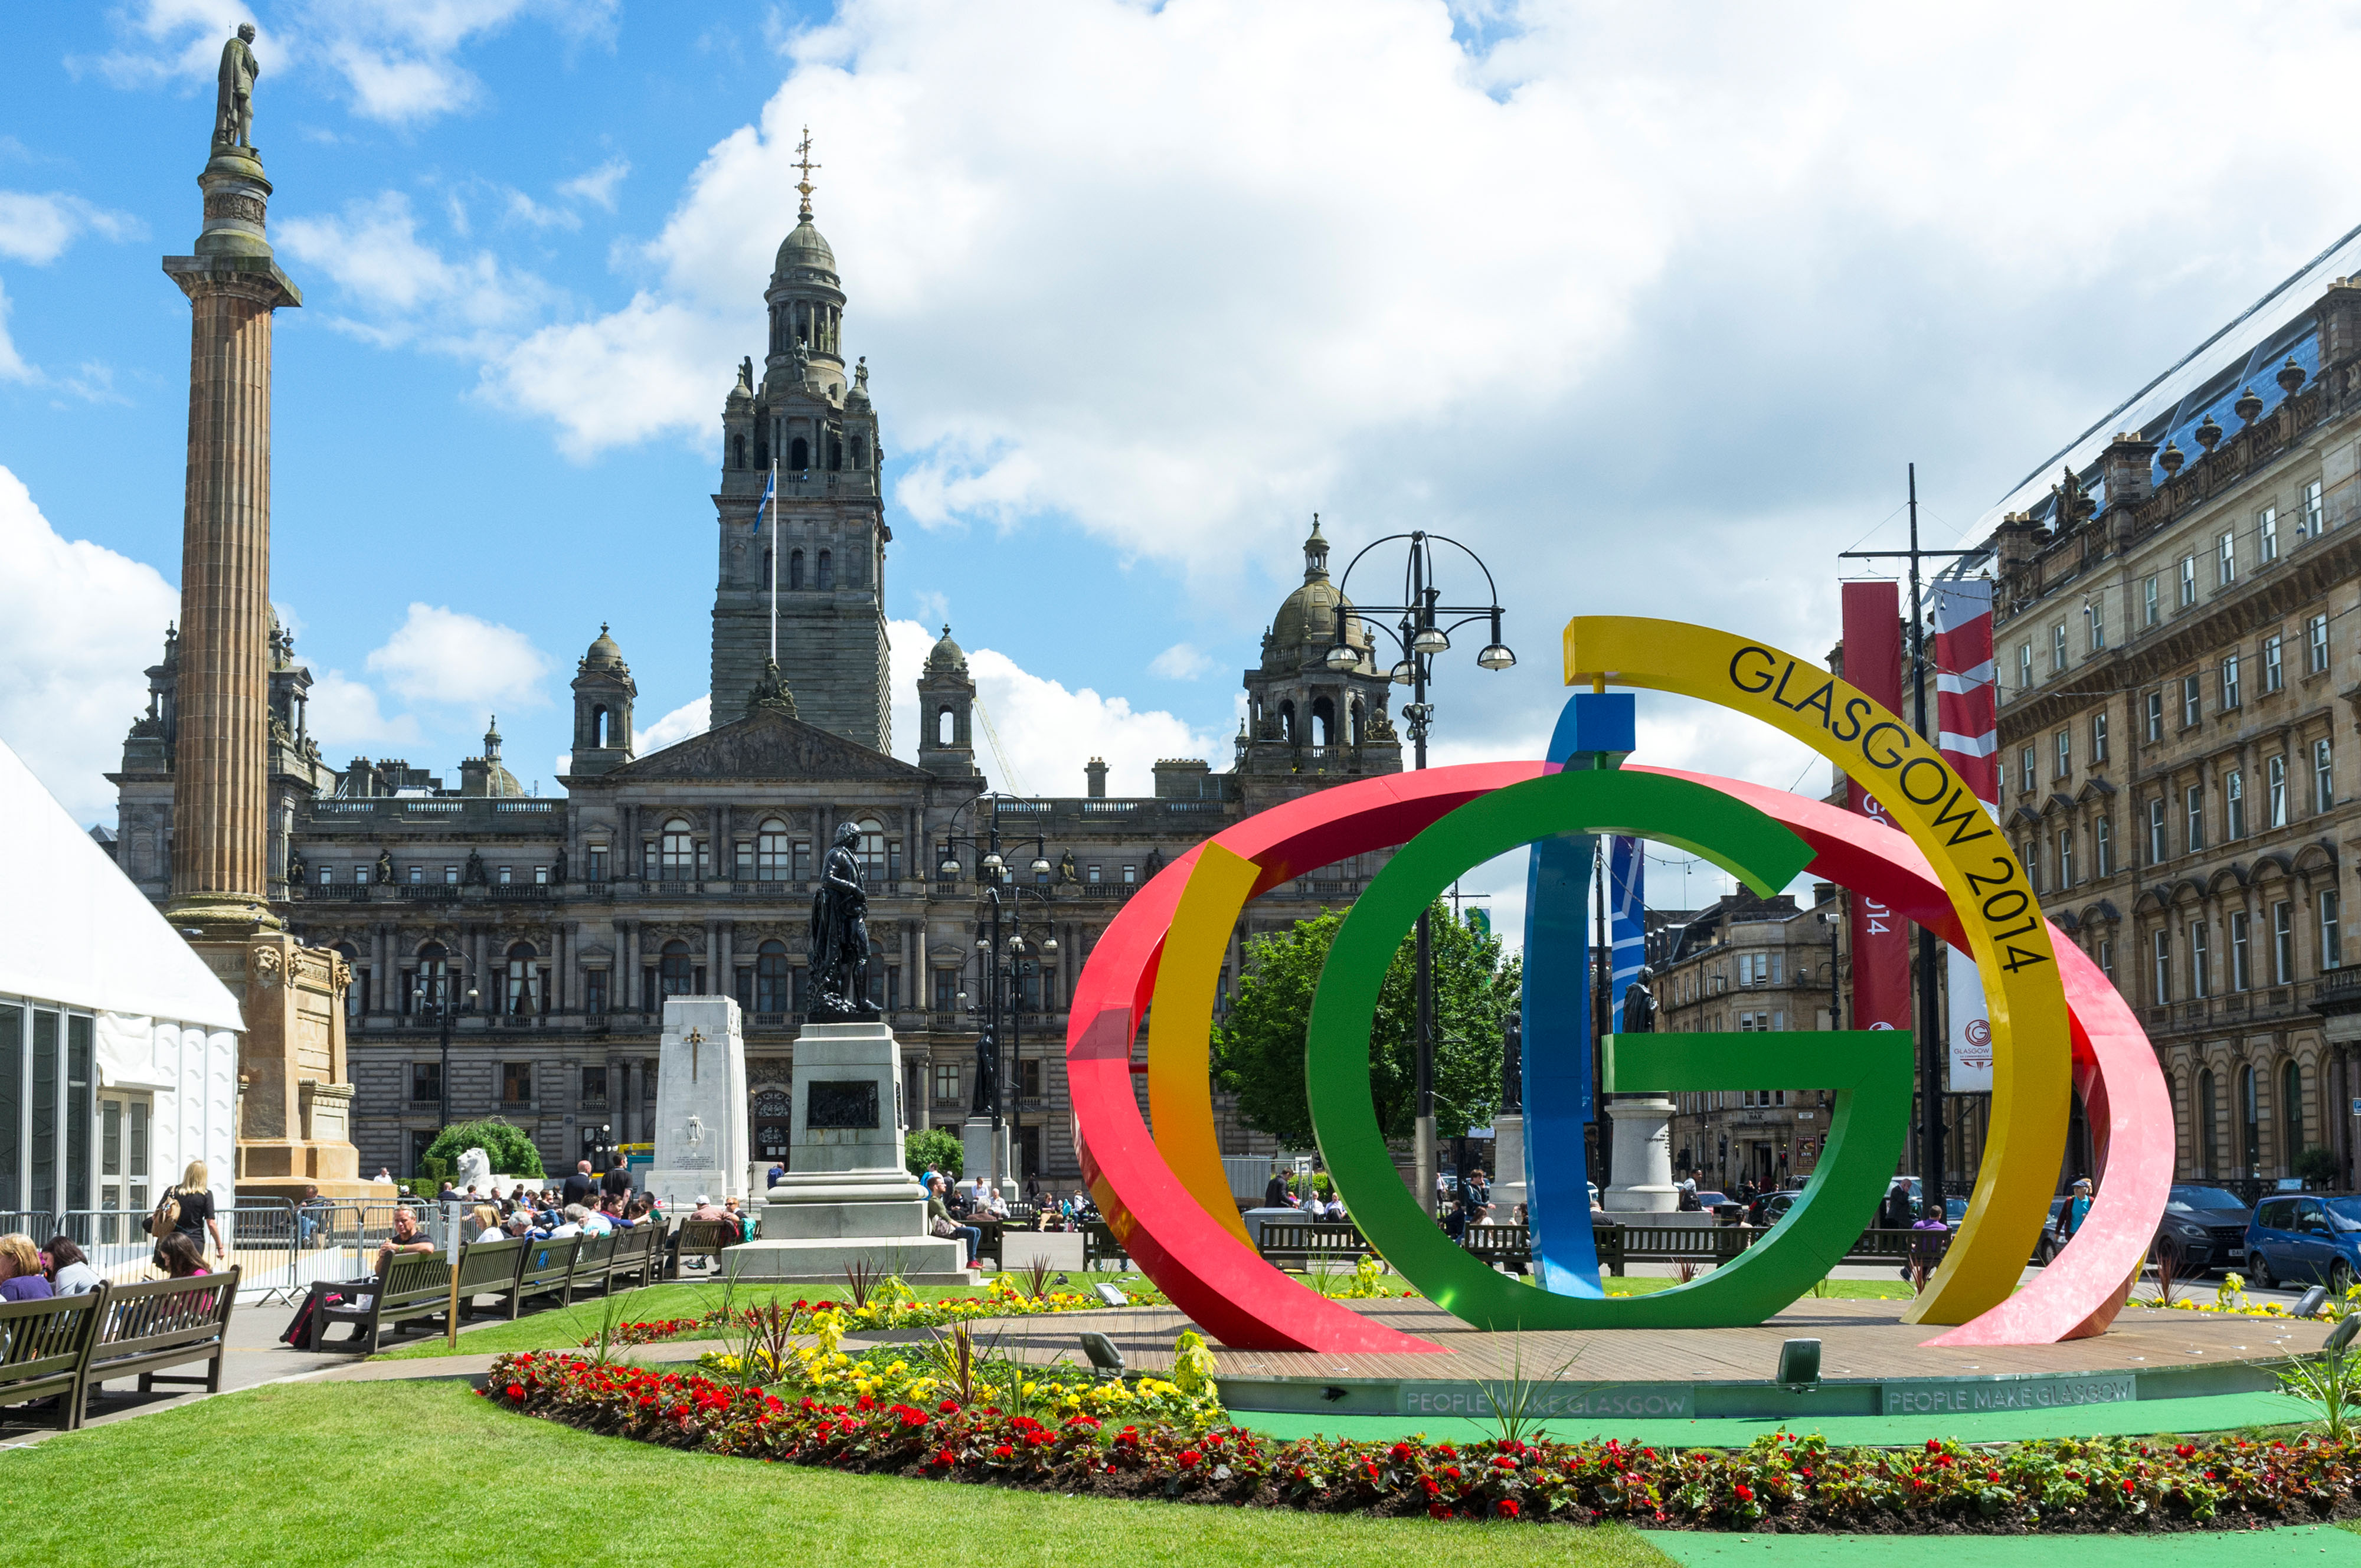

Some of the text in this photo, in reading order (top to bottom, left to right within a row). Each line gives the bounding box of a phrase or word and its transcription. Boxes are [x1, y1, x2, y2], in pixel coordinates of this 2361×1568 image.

[1729, 646, 2051, 973] GLASGOW 2014
[1407, 1392, 1487, 1412] PEOPLE
[1567, 1394, 1686, 1414] GLASGOW
[1889, 1381, 2130, 1412] PEOPLE MAKE GLASGOW
